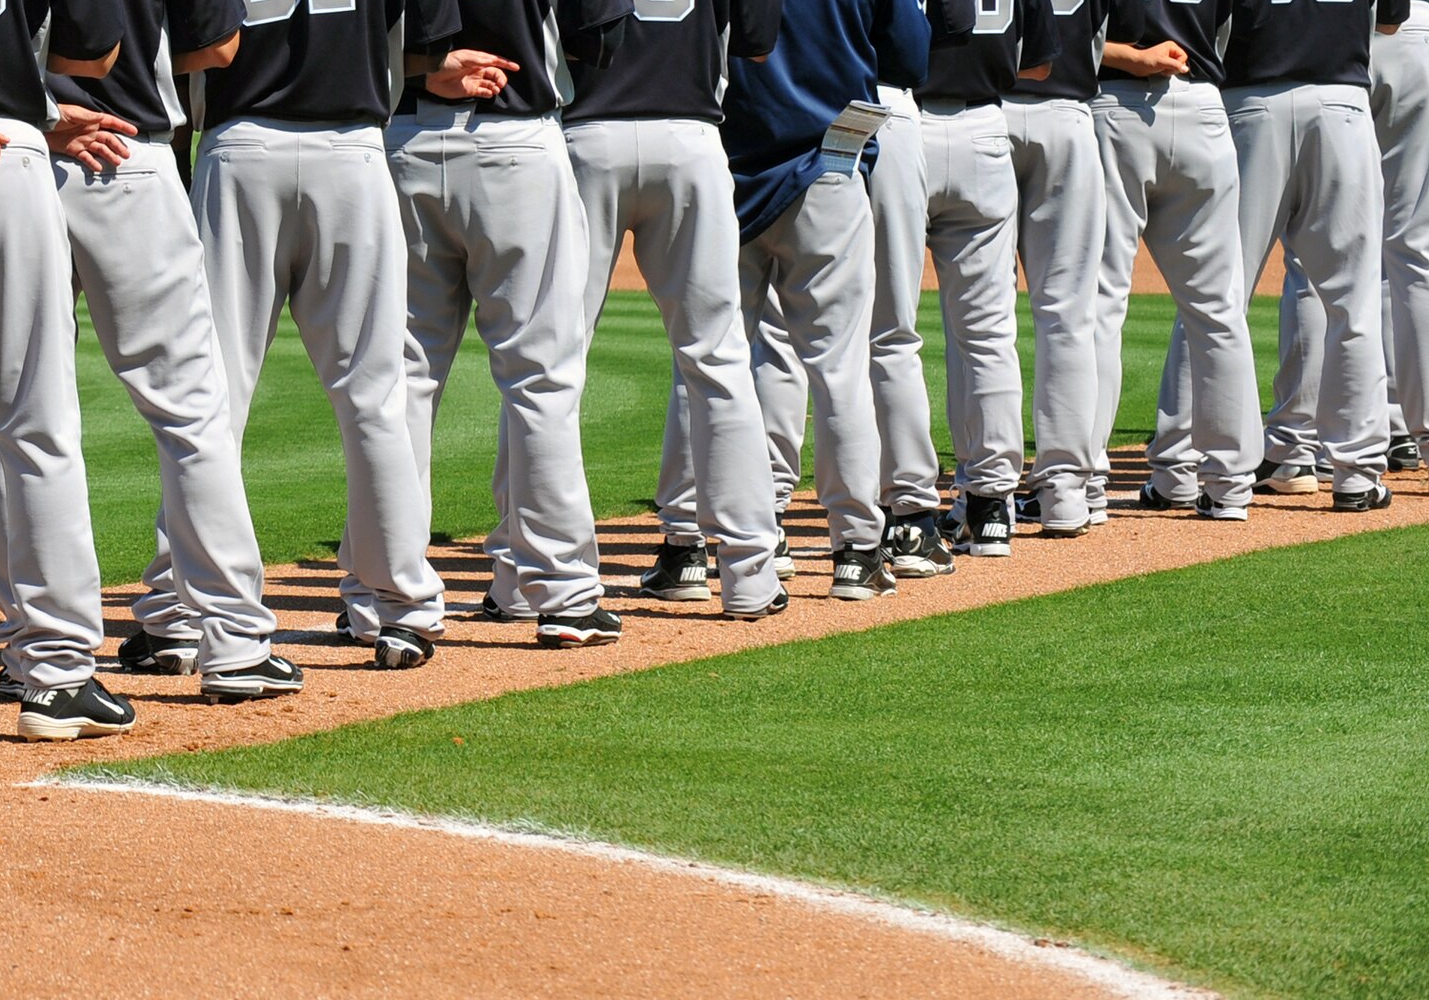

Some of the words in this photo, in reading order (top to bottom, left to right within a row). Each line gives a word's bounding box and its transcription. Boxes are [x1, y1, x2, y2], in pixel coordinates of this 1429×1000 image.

[981, 522, 1008, 538] NIKE
[679, 566, 707, 582] NIKE
[833, 564, 863, 580] NIKE
[22, 688, 58, 706] NIKE
